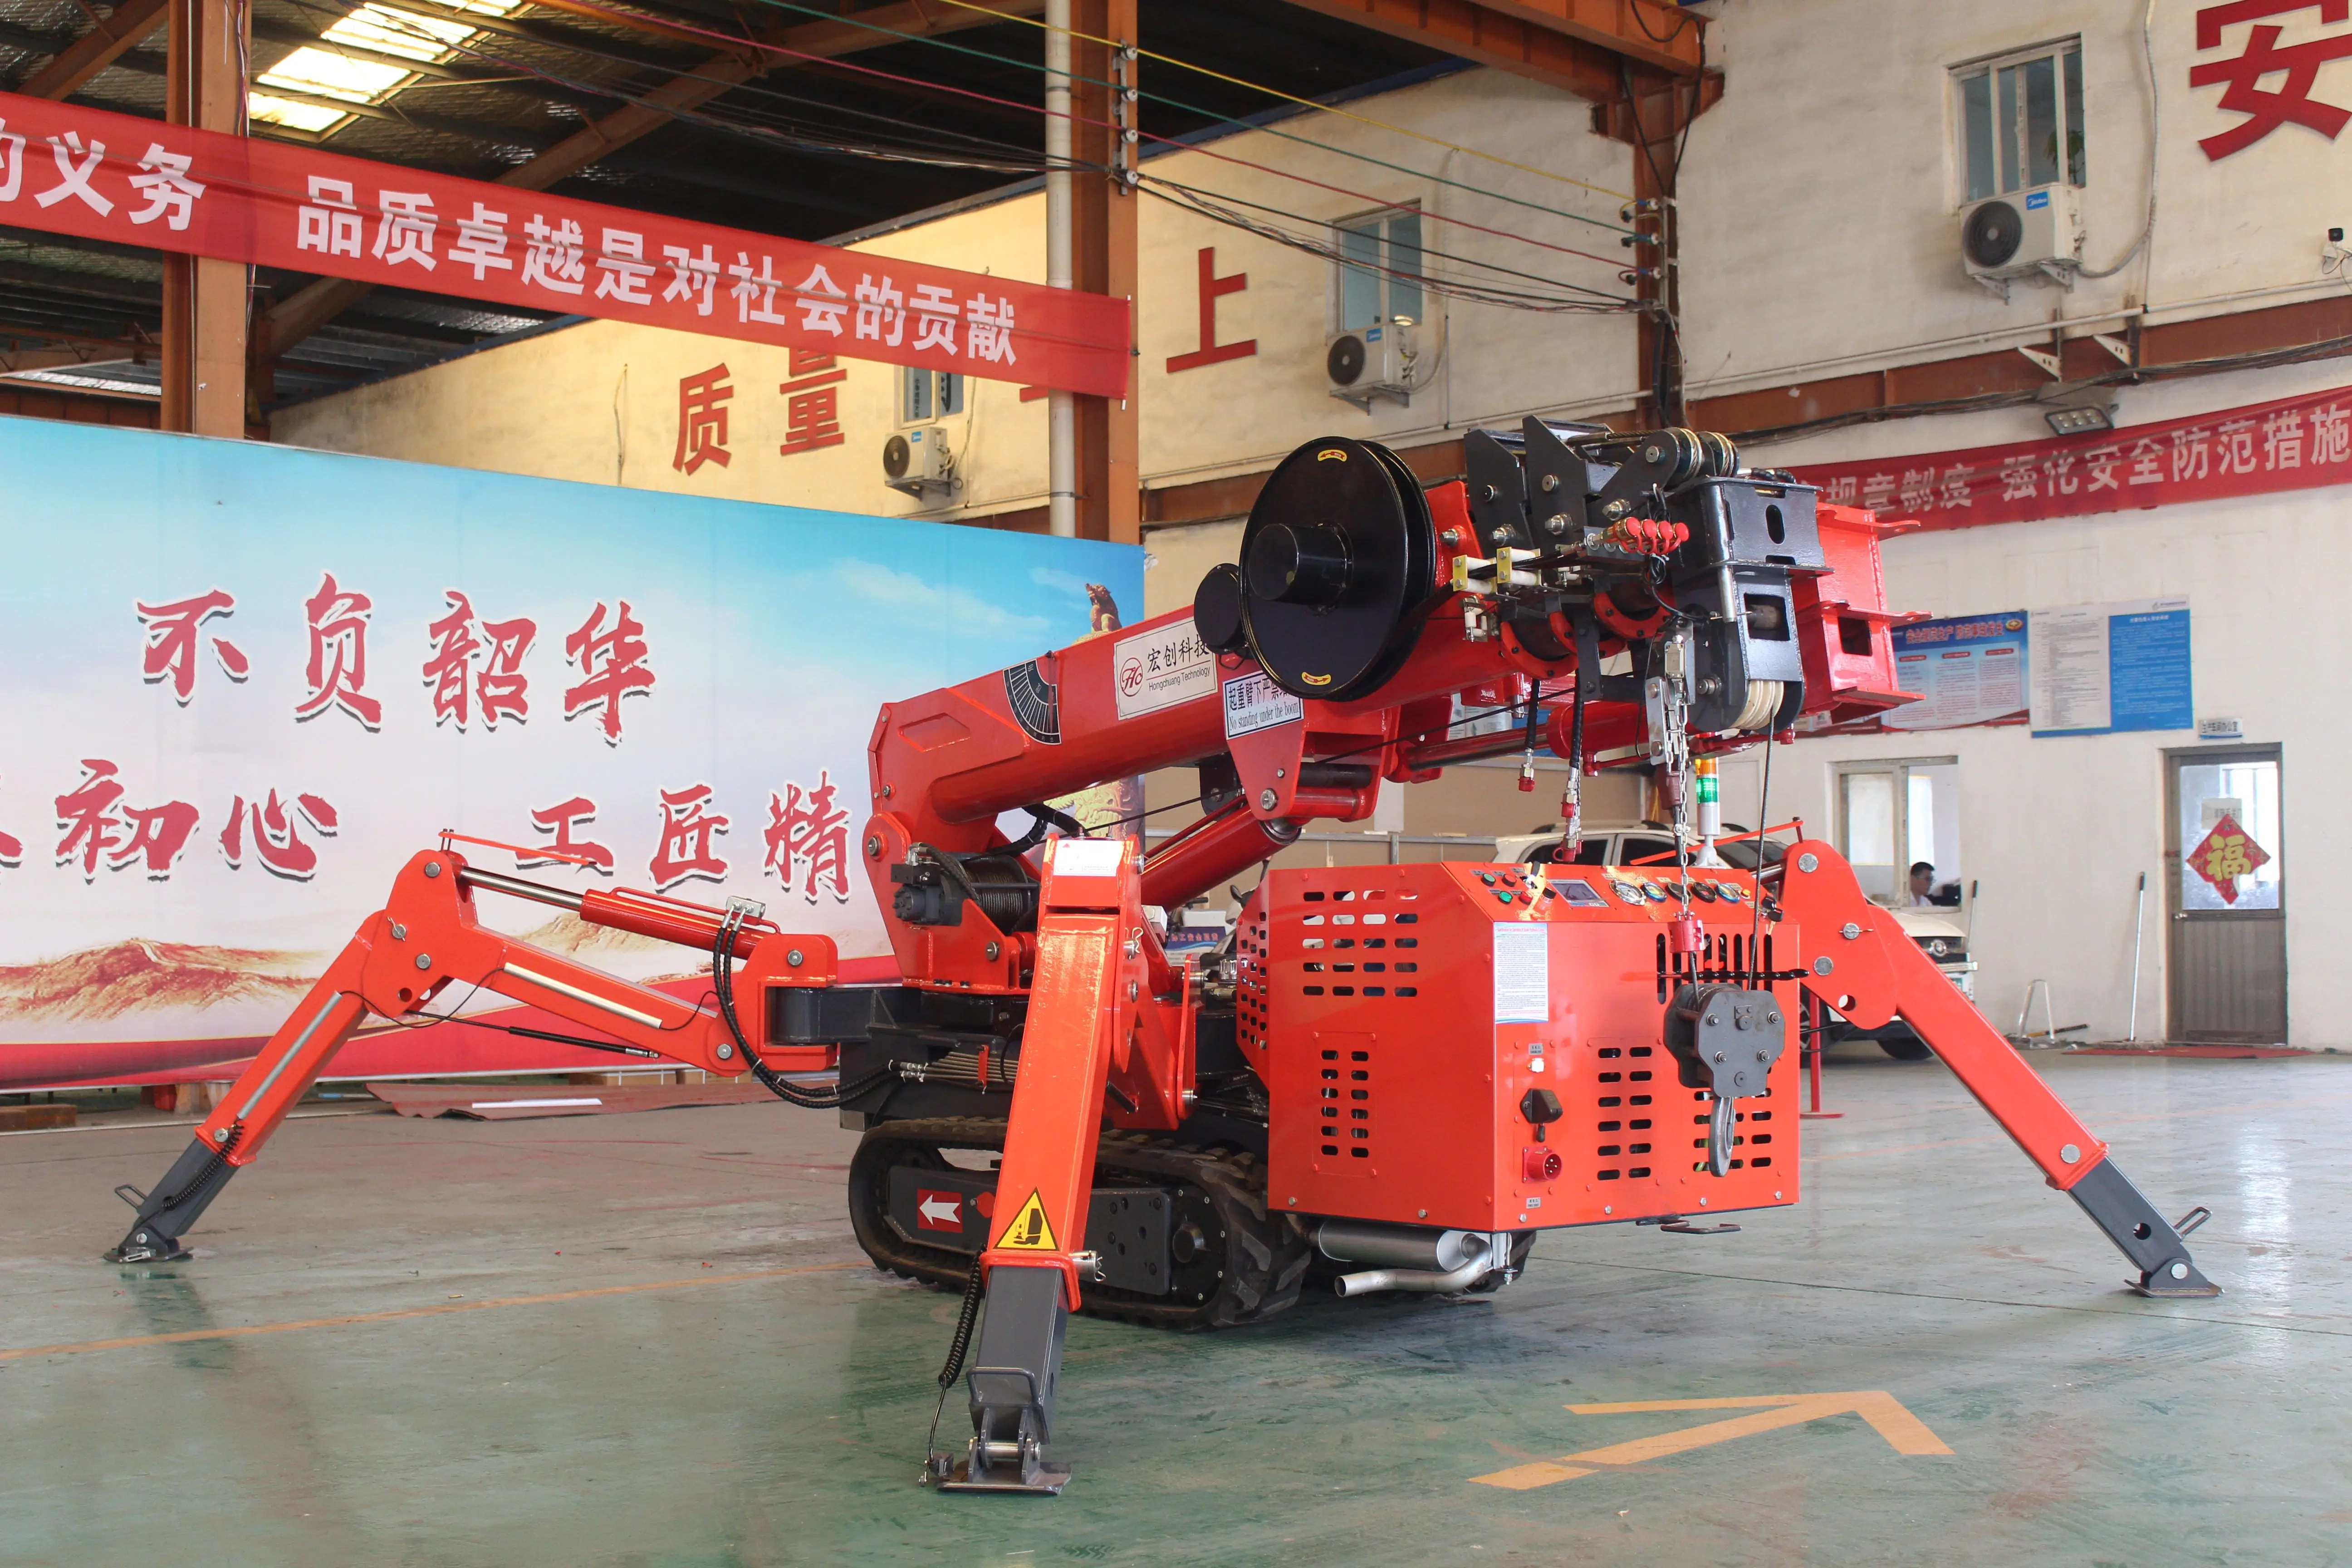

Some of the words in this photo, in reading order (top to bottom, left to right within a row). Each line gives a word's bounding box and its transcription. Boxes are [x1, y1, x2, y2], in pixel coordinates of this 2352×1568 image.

[2190, 0, 2352, 162] 安
[297, 175, 1016, 366] 品质卓越是对社会的贡献
[1798, 463, 1975, 518] 规章制度
[2002, 402, 2352, 504] 强化安全防范措施
[137, 572, 656, 744] 不负韶华
[1147, 634, 1210, 673] 宏创科技
[1149, 675, 1181, 691] Hongchuang
[1181, 666, 1210, 681] Technology
[1229, 715, 1237, 731] No
[1238, 711, 1258, 728] standing
[1259, 706, 1274, 722] under
[1275, 704, 1283, 718] the
[1284, 701, 1299, 716] boom
[515, 769, 850, 898] 工匠精
[2205, 833, 2252, 881] 福
